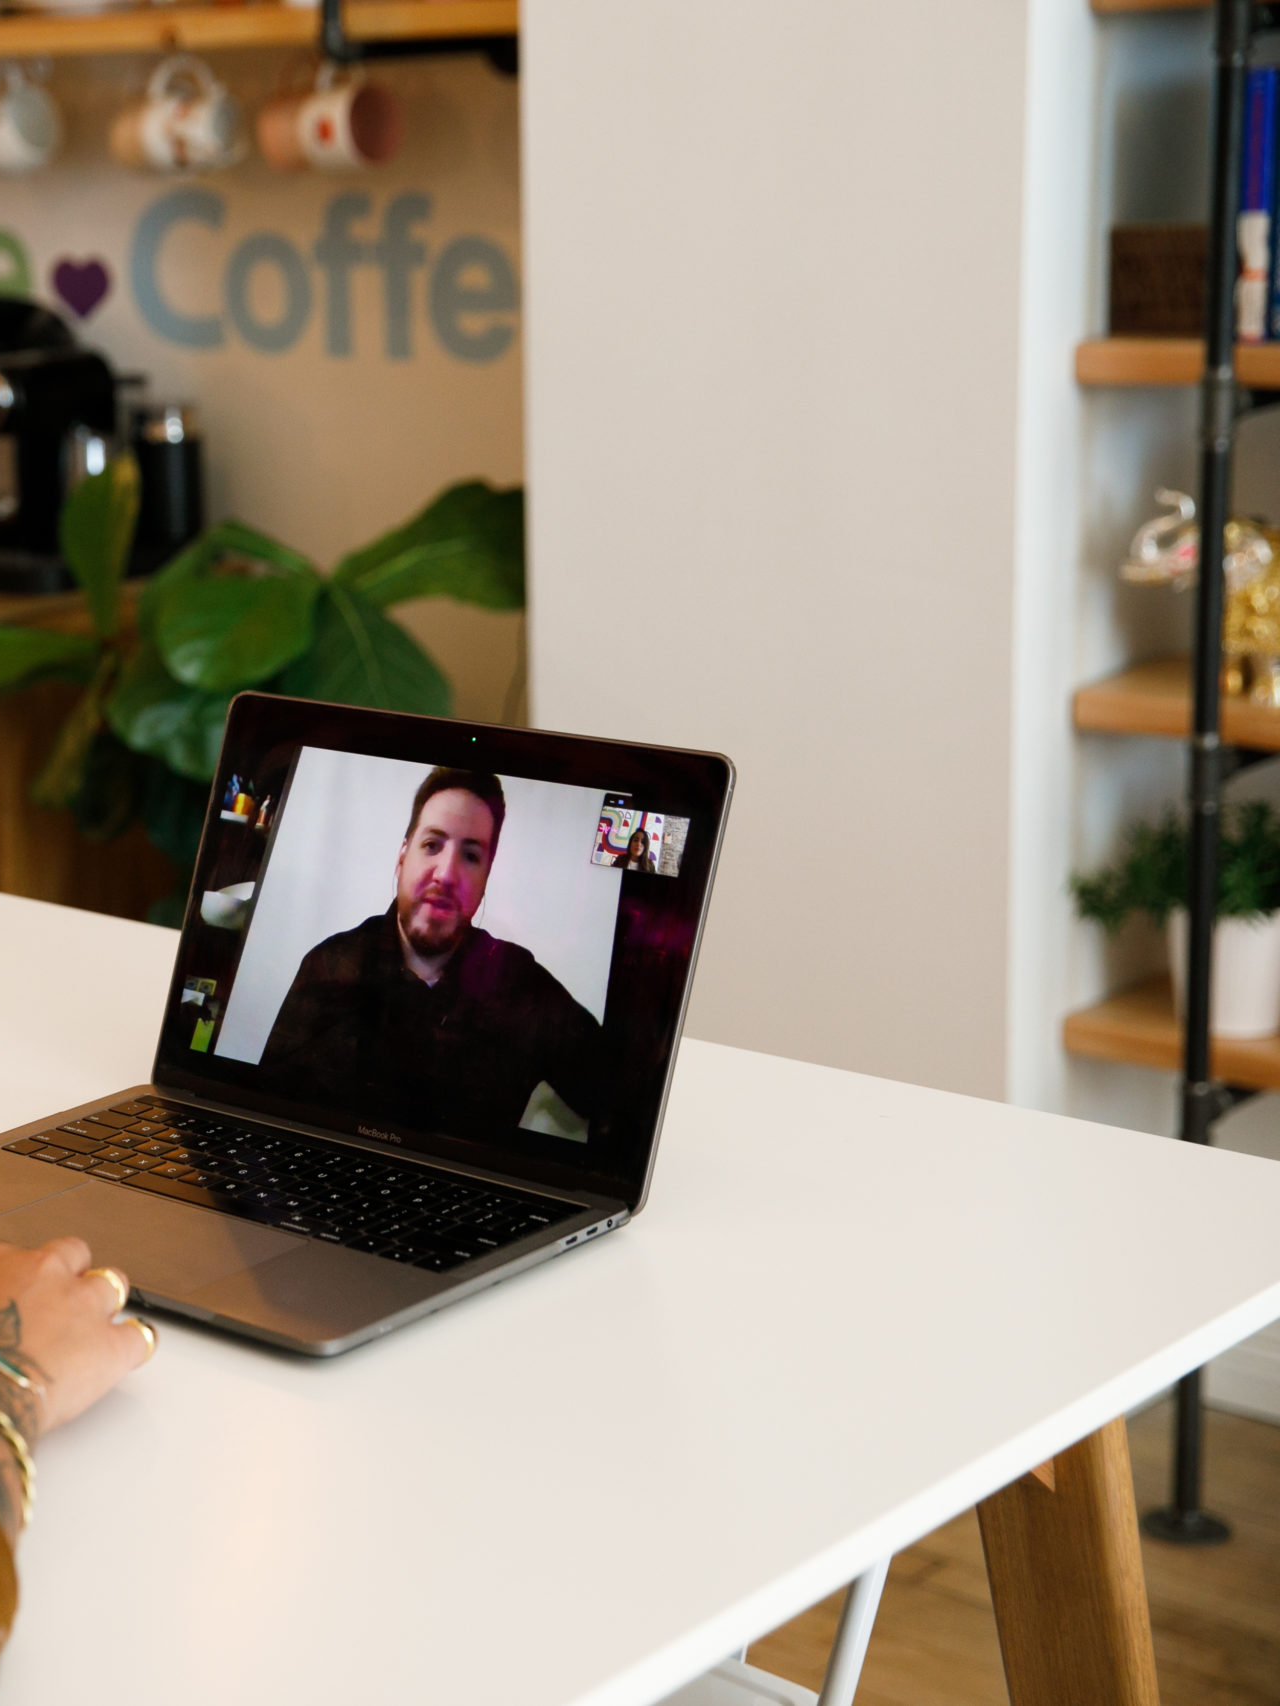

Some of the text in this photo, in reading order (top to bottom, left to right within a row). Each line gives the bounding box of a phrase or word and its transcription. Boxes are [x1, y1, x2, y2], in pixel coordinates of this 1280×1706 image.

[128, 185, 518, 363] Coffe
[357, 1125, 402, 1144] MacBook Pro
